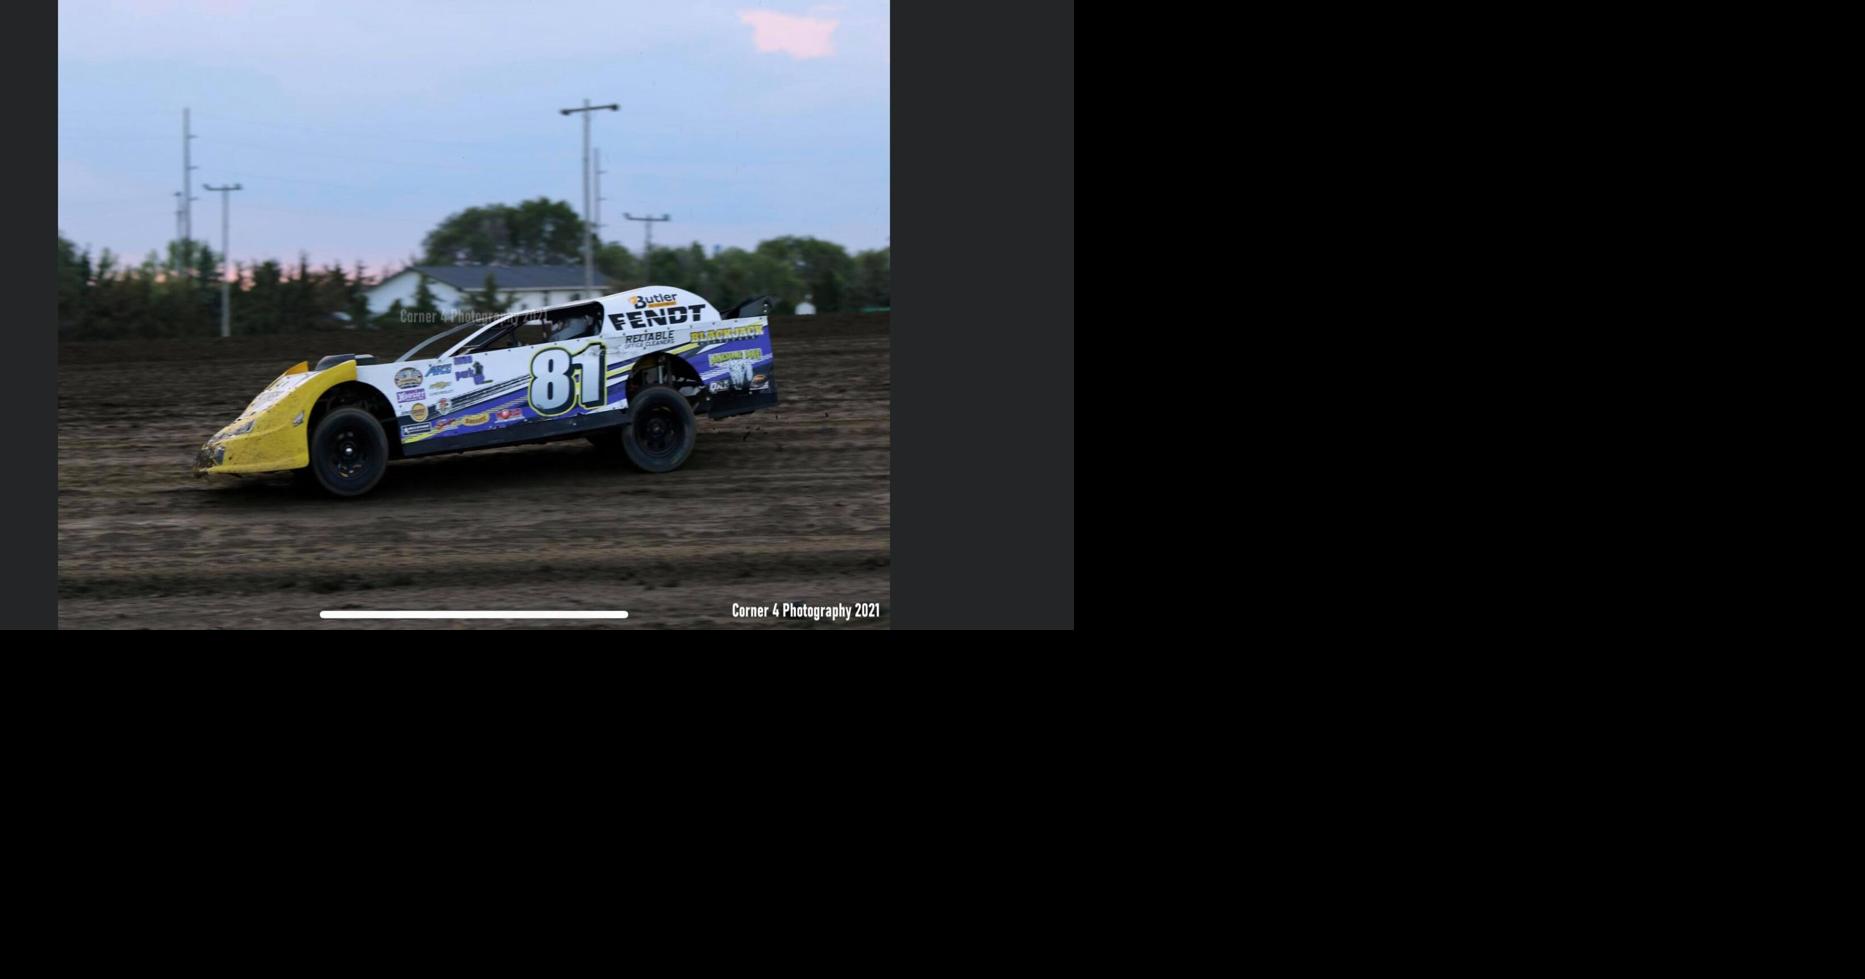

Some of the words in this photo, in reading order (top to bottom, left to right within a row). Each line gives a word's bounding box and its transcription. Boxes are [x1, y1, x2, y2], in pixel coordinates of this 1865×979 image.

[634, 293, 678, 309] Butler
[608, 304, 706, 331] FENDT
[625, 330, 674, 343] RELIABLE
[528, 341, 607, 417] 81
